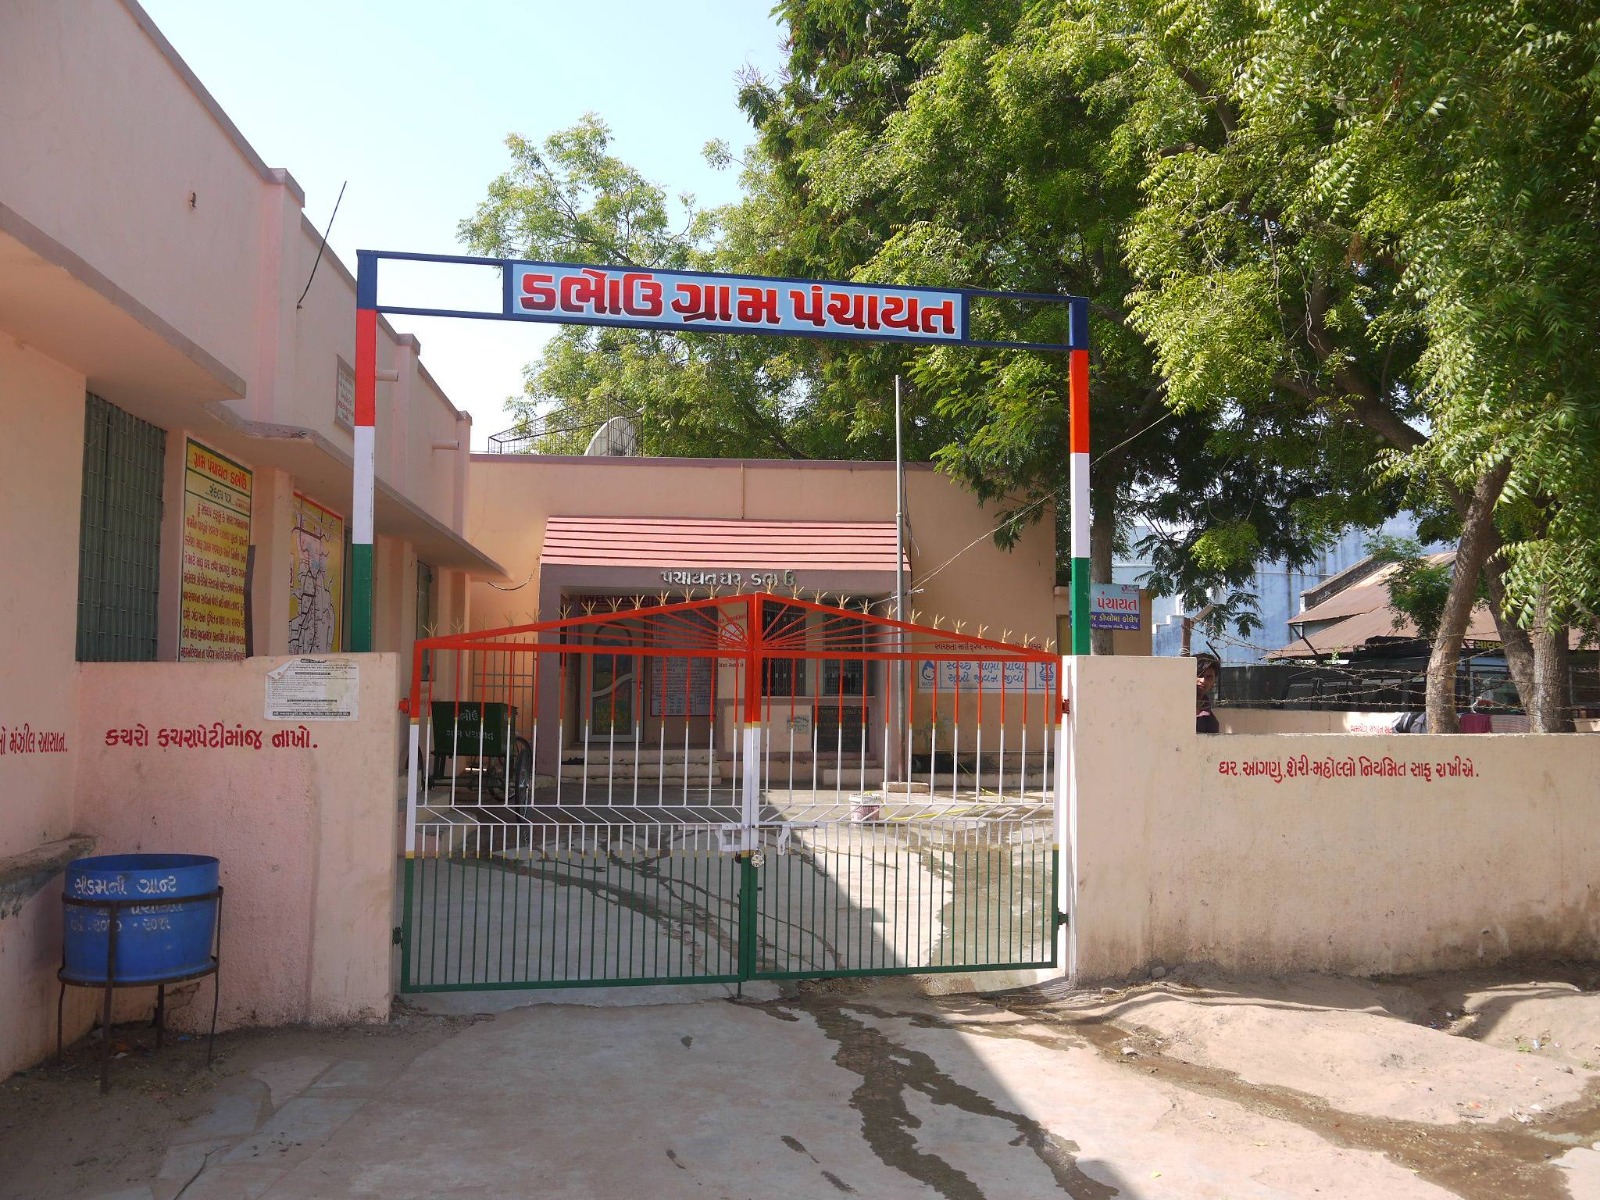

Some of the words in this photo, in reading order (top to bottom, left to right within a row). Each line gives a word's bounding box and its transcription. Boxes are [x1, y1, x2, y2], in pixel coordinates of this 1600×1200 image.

[519, 267, 663, 317] ડભોઉ
[671, 282, 782, 323] ગ્રામ
[788, 284, 957, 334] પંચાયત
[1096, 591, 1137, 611] પંચાયત
[105, 723, 149, 747] કચરો
[1358, 755, 1407, 777] નિયમિત
[1410, 761, 1432, 783] સાફ
